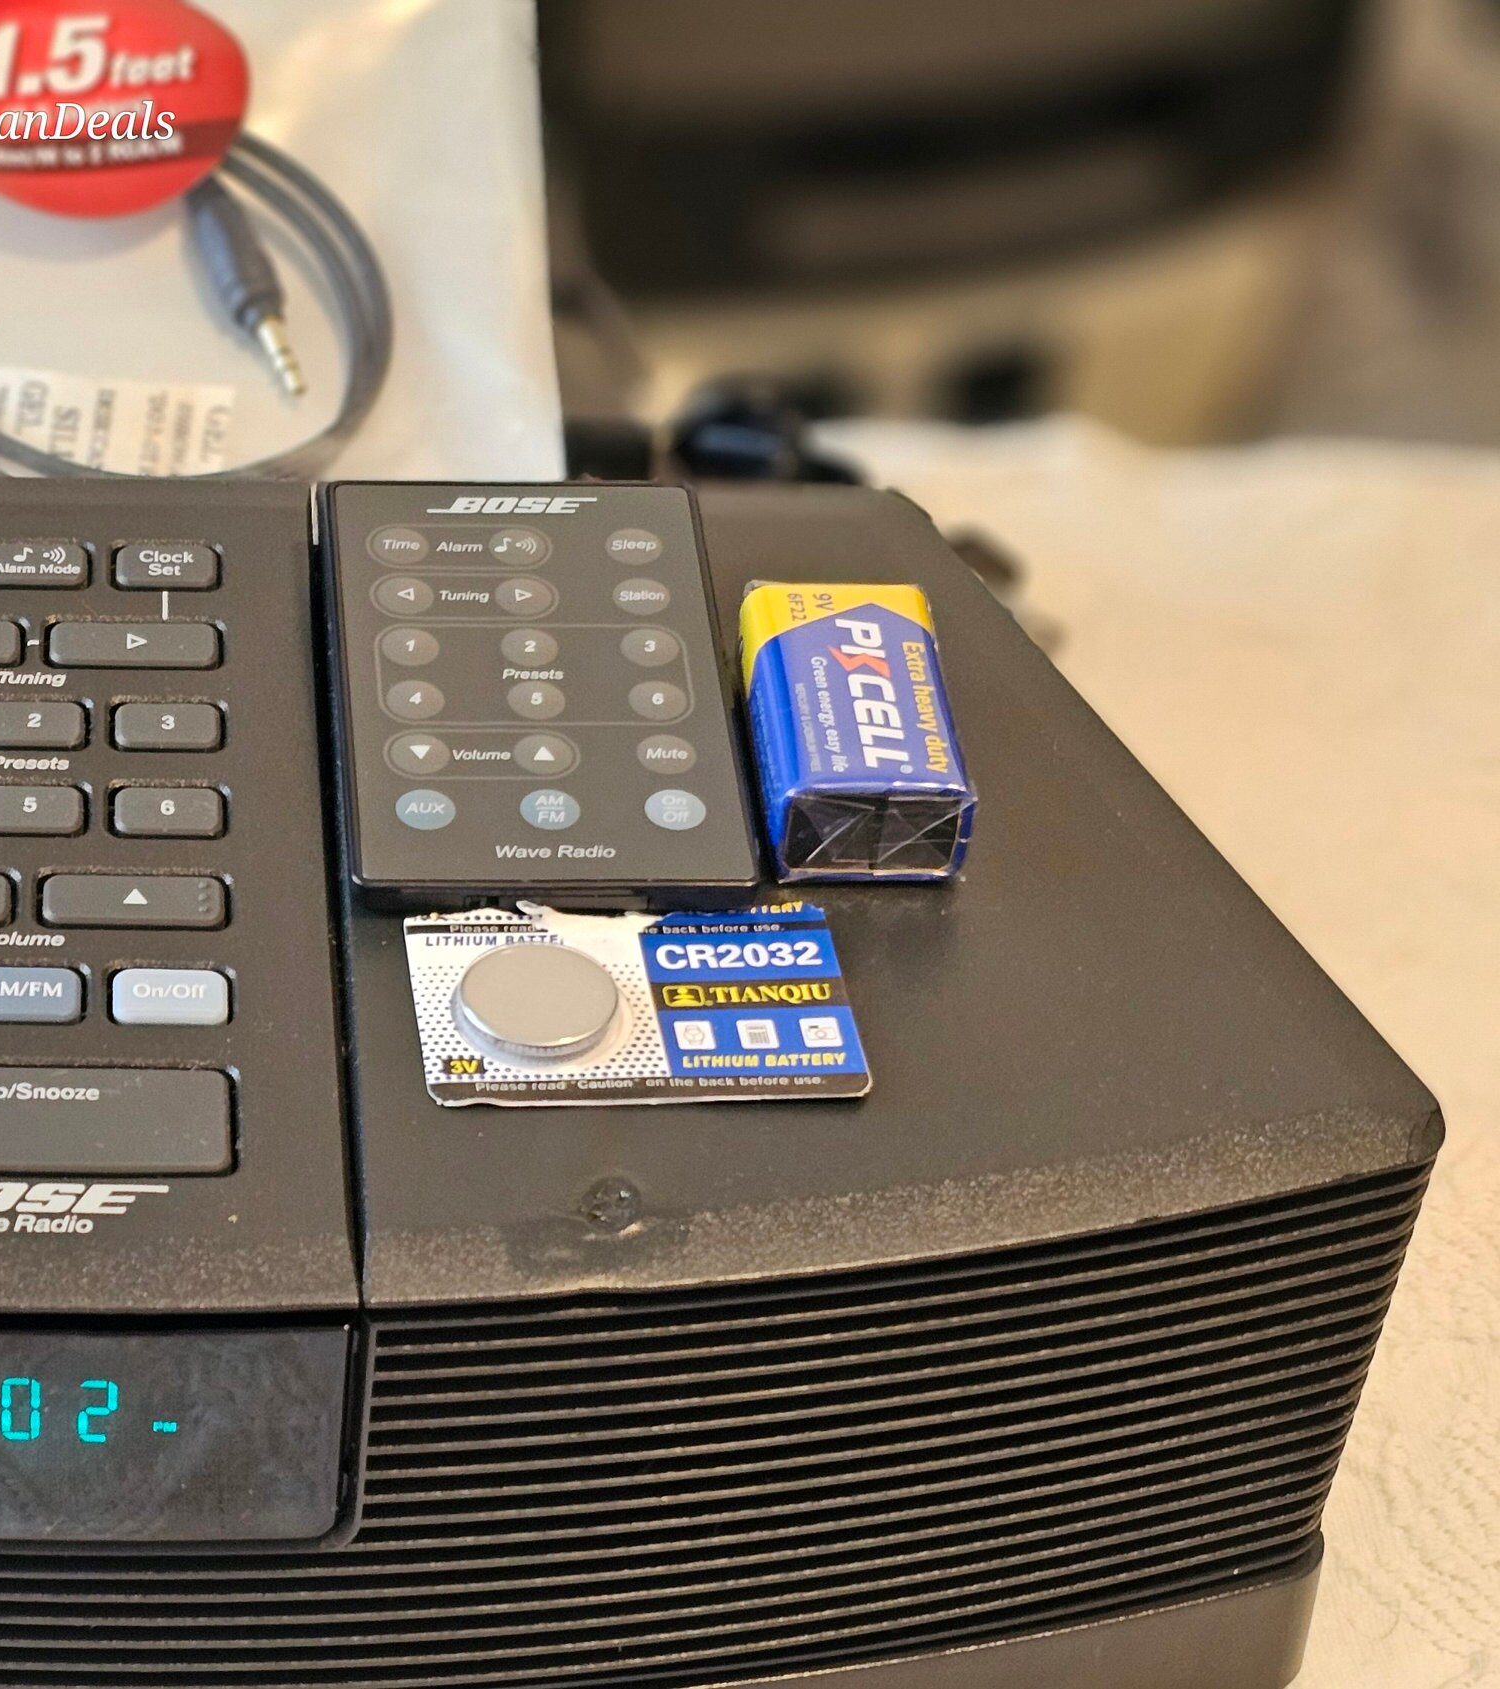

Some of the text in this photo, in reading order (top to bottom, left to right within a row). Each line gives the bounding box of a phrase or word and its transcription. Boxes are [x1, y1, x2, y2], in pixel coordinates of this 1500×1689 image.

[108, 46, 195, 87] feet
[426, 496, 597, 514] BOSE
[382, 539, 420, 551] Time
[436, 541, 483, 553] Alarm
[611, 538, 657, 553] Sleep
[139, 549, 193, 563] Clock
[39, 563, 81, 576] Mode
[148, 562, 181, 576] Set
[439, 590, 489, 603] Tuning
[618, 589, 665, 602] Station
[813, 593, 835, 611] 9V
[787, 593, 807, 621] 6F22
[405, 639, 415, 652] 1
[524, 640, 536, 652] 2
[644, 640, 656, 652] 3
[502, 668, 564, 680] Presets
[409, 691, 422, 704] 4
[531, 692, 543, 705] 5
[652, 692, 664, 705] 6
[902, 641, 949, 773] Extra heavy duty
[27, 712, 41, 728] 2
[811, 656, 848, 773] Green energy, easy life
[160, 715, 175, 730] 3
[452, 748, 511, 761] Volume
[646, 748, 688, 760] Mute
[22, 797, 37, 813] 5
[535, 796, 564, 806] AM
[662, 795, 687, 805] On
[160, 800, 175, 816] 6
[405, 802, 445, 815] AUX
[537, 811, 565, 823] FM
[663, 810, 690, 822] Off
[495, 845, 616, 859] Wave Radio
[450, 924, 499, 933] Please
[662, 925, 697, 934] back
[702, 923, 748, 934] before
[425, 934, 564, 947] LITHIUM BATTE
[655, 941, 823, 969] CR2032
[132, 982, 207, 999] On/Off
[709, 983, 832, 1004] TIANQIU
[682, 1052, 846, 1068] LITHIUM BATTERY
[450, 1060, 478, 1074] 3V
[475, 1082, 527, 1092] Please
[531, 1081, 567, 1091] read
[646, 1078, 665, 1087] on
[669, 1077, 693, 1087] the
[699, 1076, 734, 1087] back
[739, 1075, 790, 1086] before
[14, 1214, 94, 1234] Radio
[152, 1420, 178, 1434] PM
